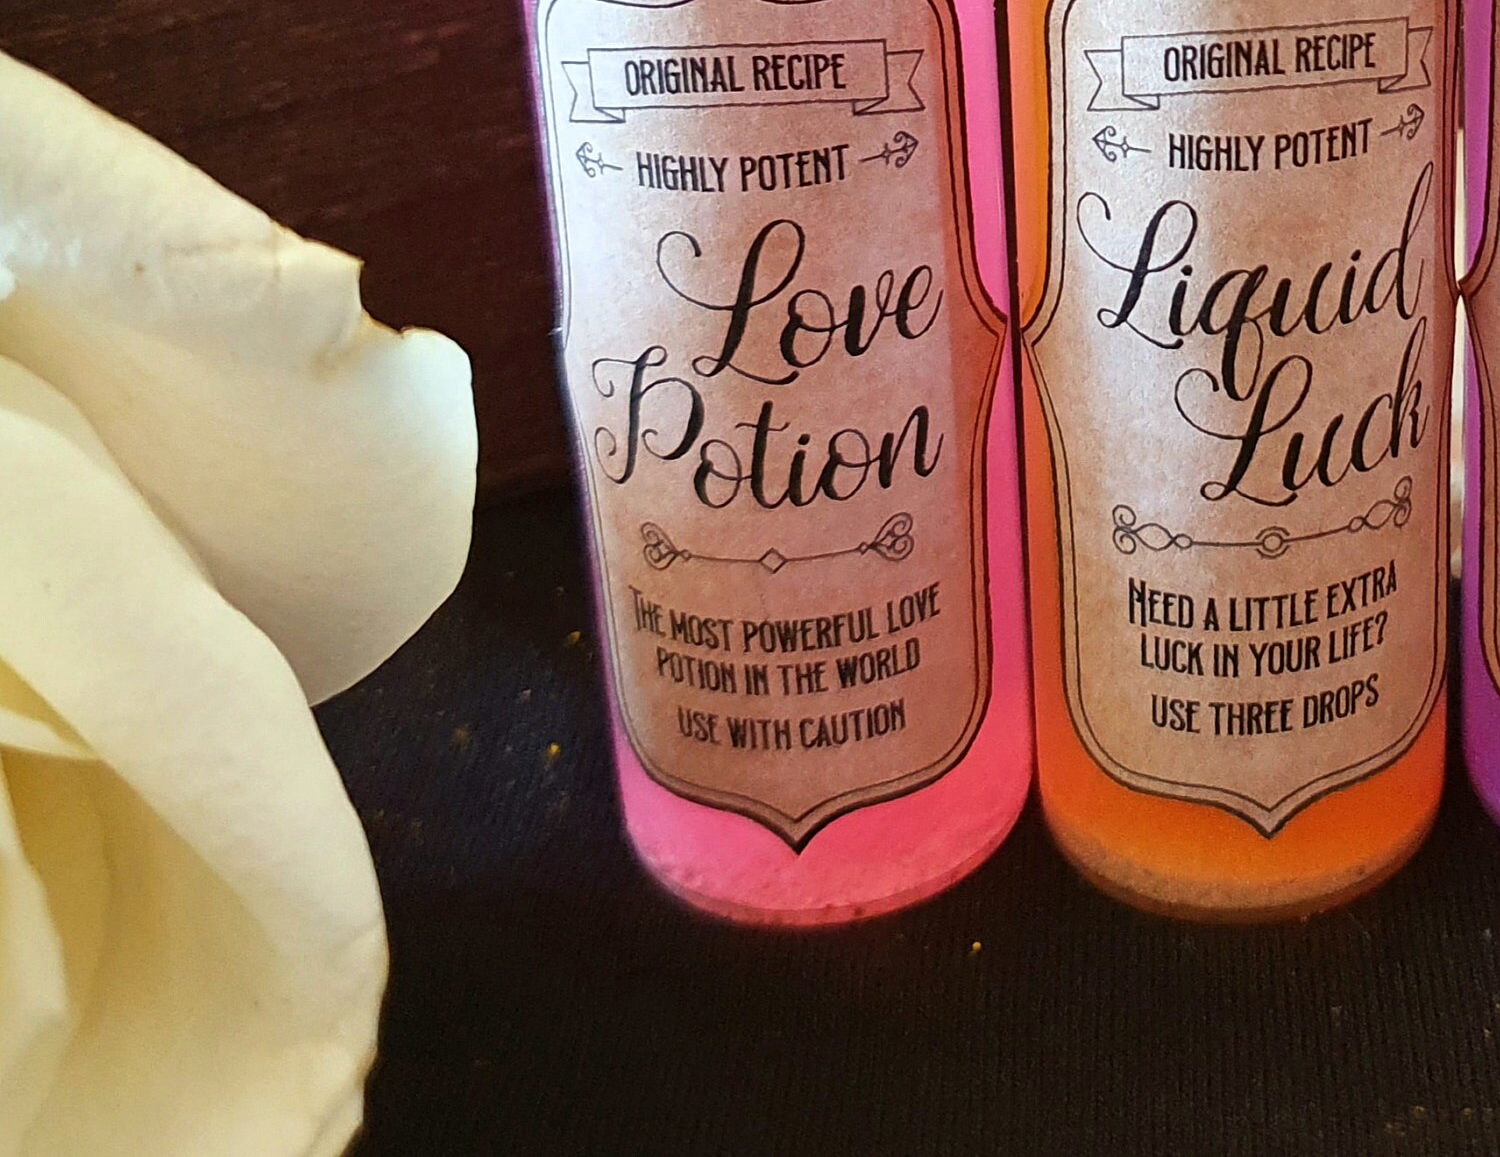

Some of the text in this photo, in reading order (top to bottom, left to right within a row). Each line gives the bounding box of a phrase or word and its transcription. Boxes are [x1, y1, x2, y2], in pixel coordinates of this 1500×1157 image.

[624, 53, 847, 95] ORIGINAL RECIPE
[1164, 33, 1377, 82] ORIGINAL RECIPE
[636, 144, 849, 193] HIGHLY POTENT
[1169, 118, 1373, 172] HIGHLY POTENT
[656, 219, 944, 385] Love
[1076, 161, 1433, 401] Liquid
[592, 346, 944, 509] Potion
[1174, 316, 1430, 507] Luck
[669, 609, 732, 651] MOST
[743, 606, 878, 653] POWERFUL
[887, 581, 941, 632] LOVE
[1204, 597, 1219, 632] A
[1229, 589, 1318, 632] LITTLE
[1327, 560, 1397, 617] EXTRA
[656, 638, 920, 697] POTION IN THE WORLD
[1213, 644, 1239, 677] IN
[1250, 635, 1320, 677] YOUR
[1328, 611, 1388, 663] LIFE?
[678, 698, 906, 750] USE WITH CAUTION
[1151, 674, 1380, 736] USE THREE DROPS
